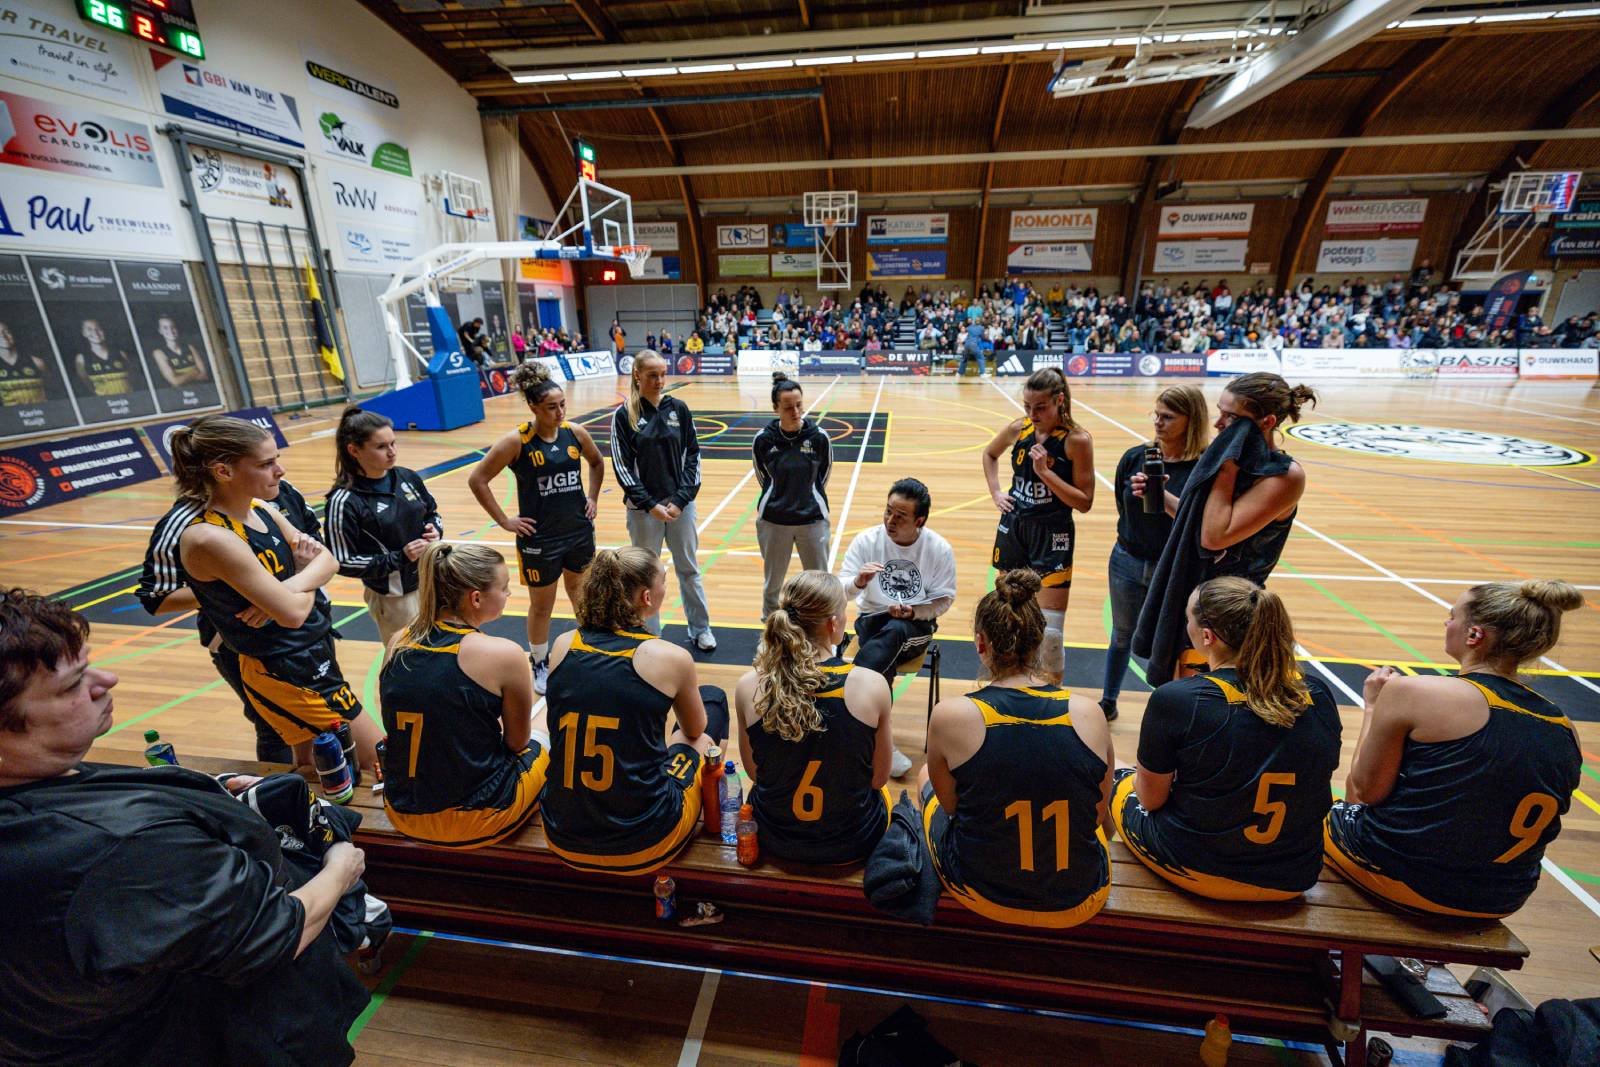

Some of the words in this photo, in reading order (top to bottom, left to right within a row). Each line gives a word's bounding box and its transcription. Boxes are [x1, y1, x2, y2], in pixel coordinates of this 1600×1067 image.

[90, 0, 124, 29] 26
[29, 18, 109, 53] TRAVEL
[179, 32, 202, 57] 19
[37, 43, 73, 64] travel
[76, 58, 89, 69] in
[93, 61, 119, 81] style
[203, 70, 228, 89] GBI
[229, 79, 252, 97] VAN
[254, 87, 275, 103] DIJK
[309, 63, 398, 105] WERKTALENT
[39, 134, 154, 163] CARDPRINTERS
[332, 135, 366, 158] VALK
[27, 195, 95, 234] Paul
[97, 216, 172, 230] TWEEWIELERS
[1014, 212, 1093, 227] ROMONTA
[1182, 211, 1248, 222] OUWEHAND
[638, 226, 675, 235] BERGMAN
[1323, 245, 1365, 258] potters
[1561, 241, 1576, 249] VAN
[1577, 240, 1594, 248] DER
[1330, 255, 1363, 266] vooijs
[132, 281, 182, 291] HAASNOOT
[888, 353, 903, 362] DE
[906, 353, 929, 362] WIT
[1032, 354, 1064, 362] ADIDAS
[1440, 354, 1518, 366] BASIS
[1538, 356, 1594, 365] OUWEHAND
[528, 450, 545, 467] 10
[1016, 448, 1026, 465] 8
[257, 548, 284, 575] 12
[993, 547, 1000, 563] 8
[526, 568, 540, 582] 10
[331, 683, 357, 709] 12
[396, 711, 424, 778] 7
[558, 711, 620, 792] 15
[792, 760, 824, 822] 6
[1243, 772, 1296, 845] 5
[1004, 799, 1069, 872] 11
[1492, 792, 1559, 864] 9
